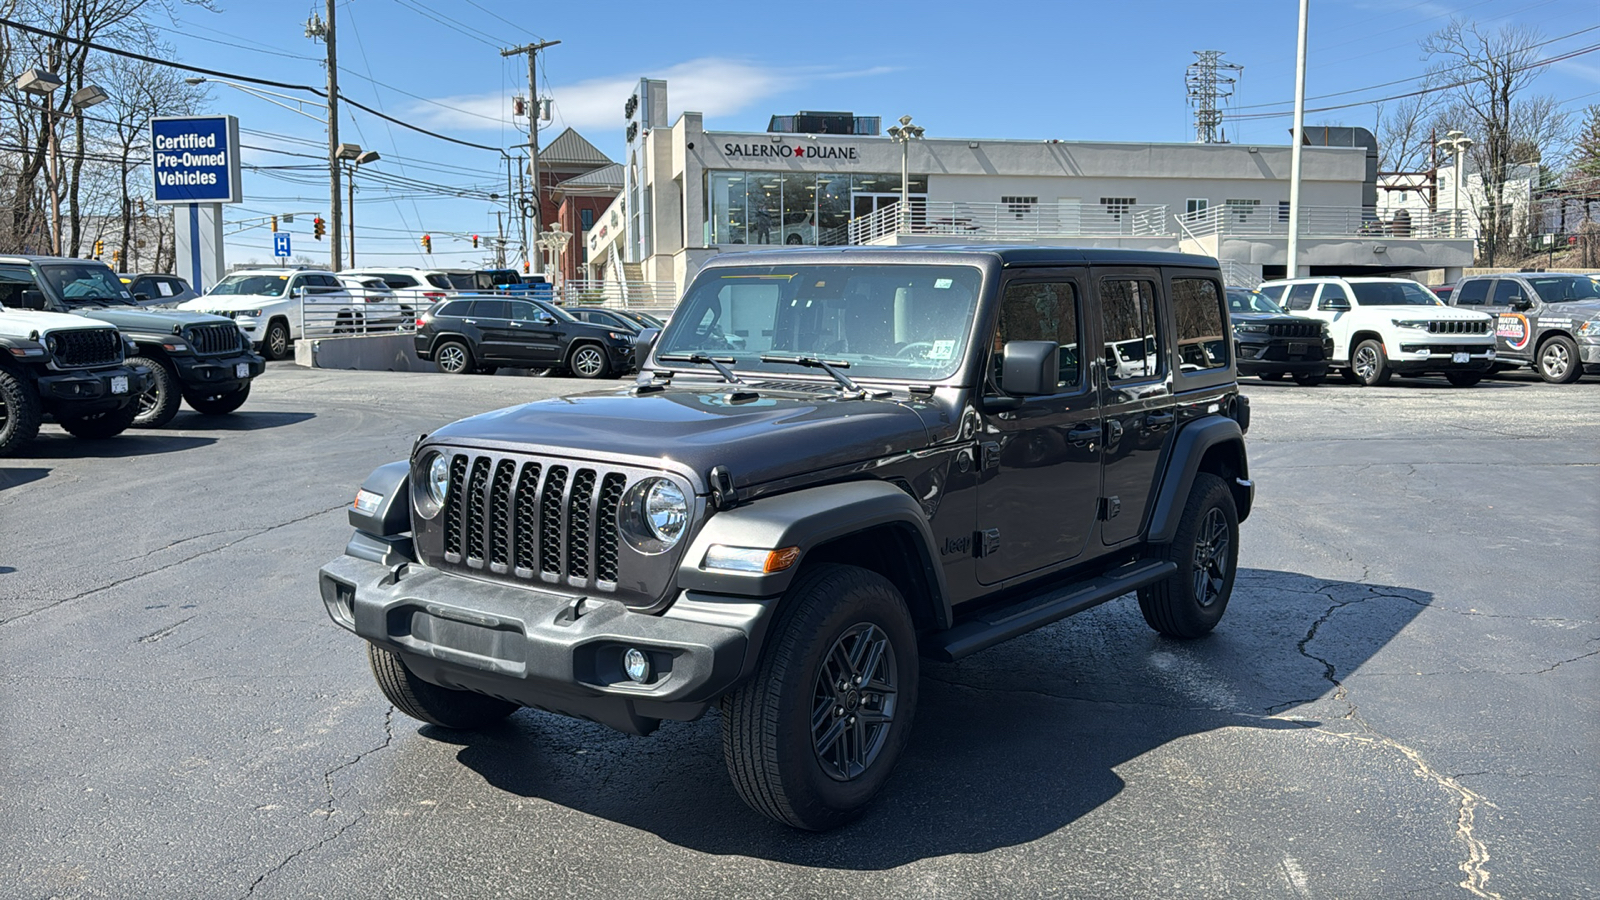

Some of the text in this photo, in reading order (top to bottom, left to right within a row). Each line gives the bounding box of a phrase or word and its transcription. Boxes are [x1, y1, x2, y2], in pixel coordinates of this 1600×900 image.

[155, 133, 215, 149] Certified
[157, 151, 225, 167] Pre-Owned
[724, 143, 857, 160] SALERNO DUANE
[158, 170, 217, 186] Vehicles
[277, 237, 288, 250] H
[1497, 324, 1523, 332] HEATERS
[940, 536, 971, 556] Jeep
